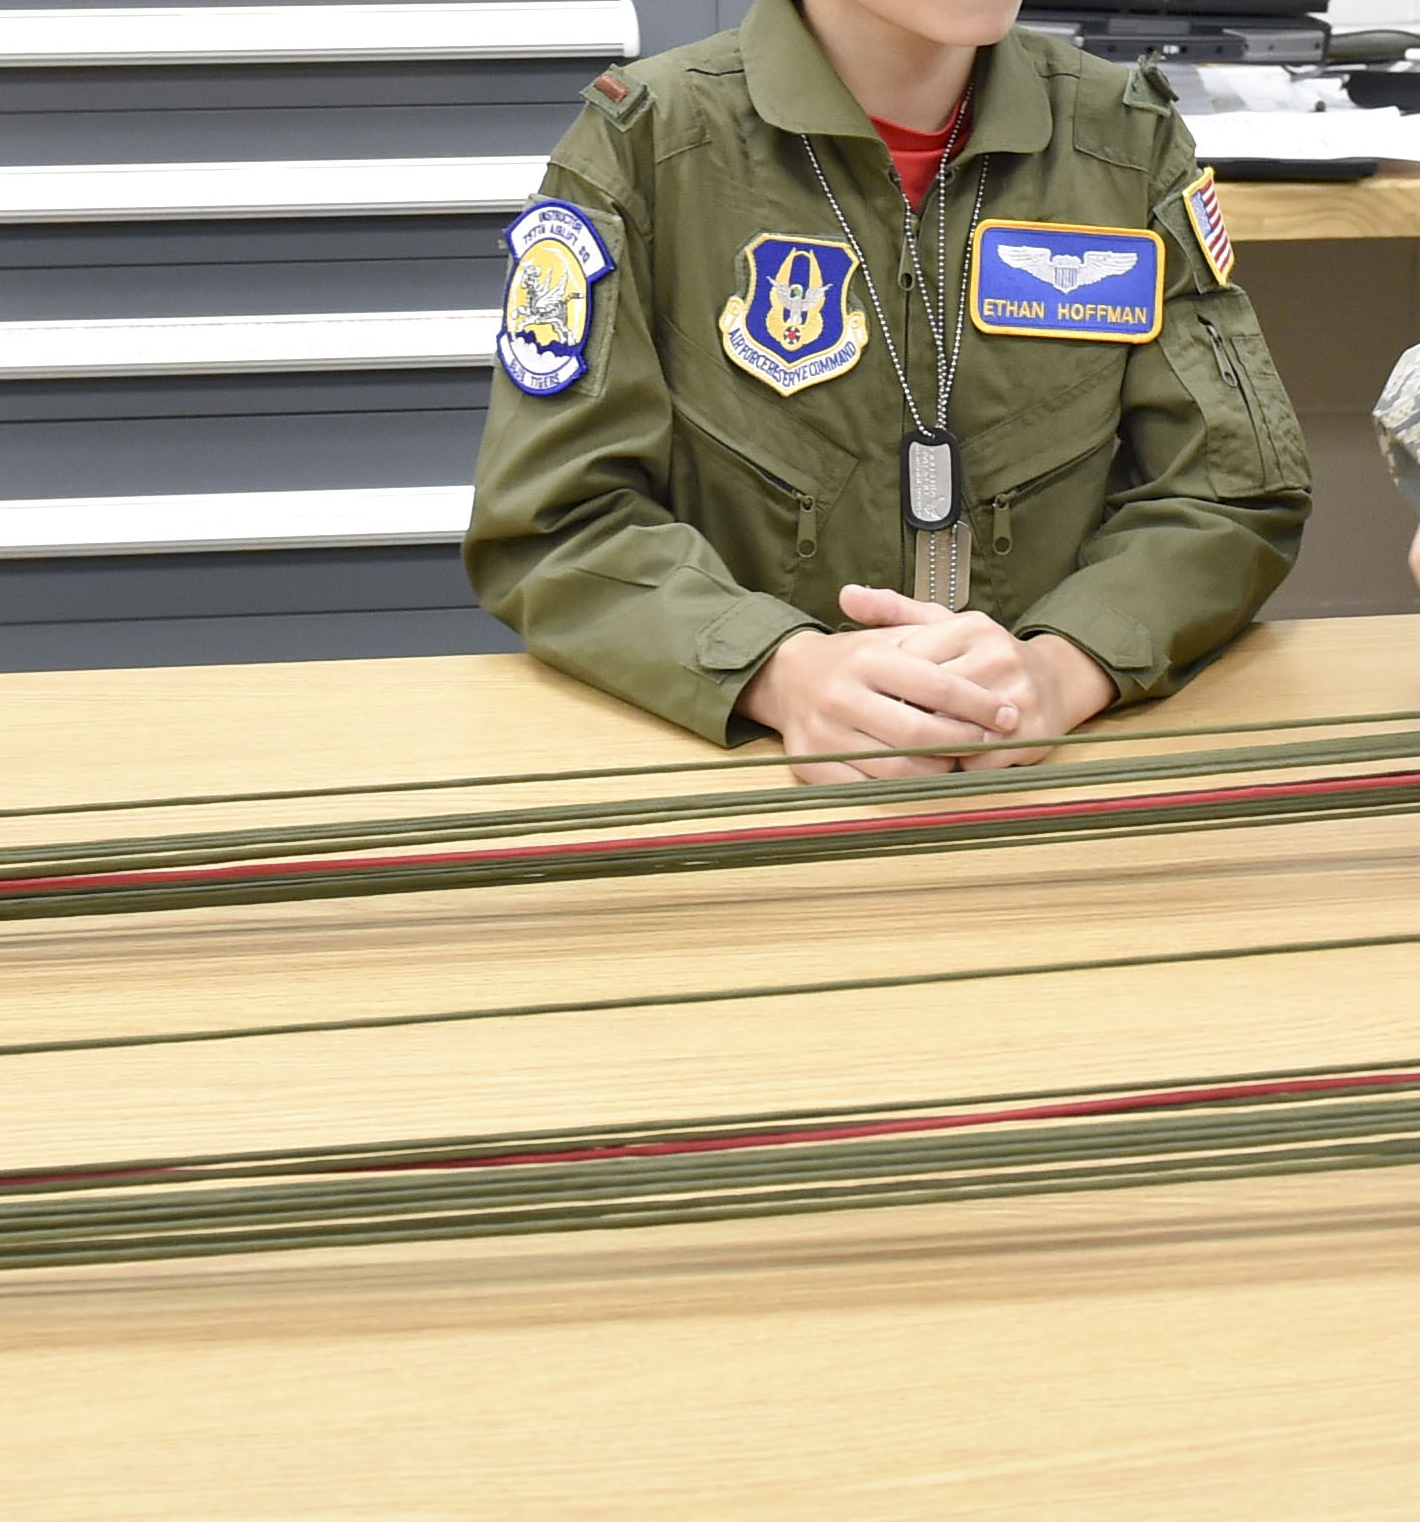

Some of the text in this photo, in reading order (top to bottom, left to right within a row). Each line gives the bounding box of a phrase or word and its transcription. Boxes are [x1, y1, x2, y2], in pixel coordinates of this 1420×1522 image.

[982, 298, 1148, 325] ETHAN HOFFMAN
[729, 327, 857, 388] AIR FORCE RESERVE COMMAND
